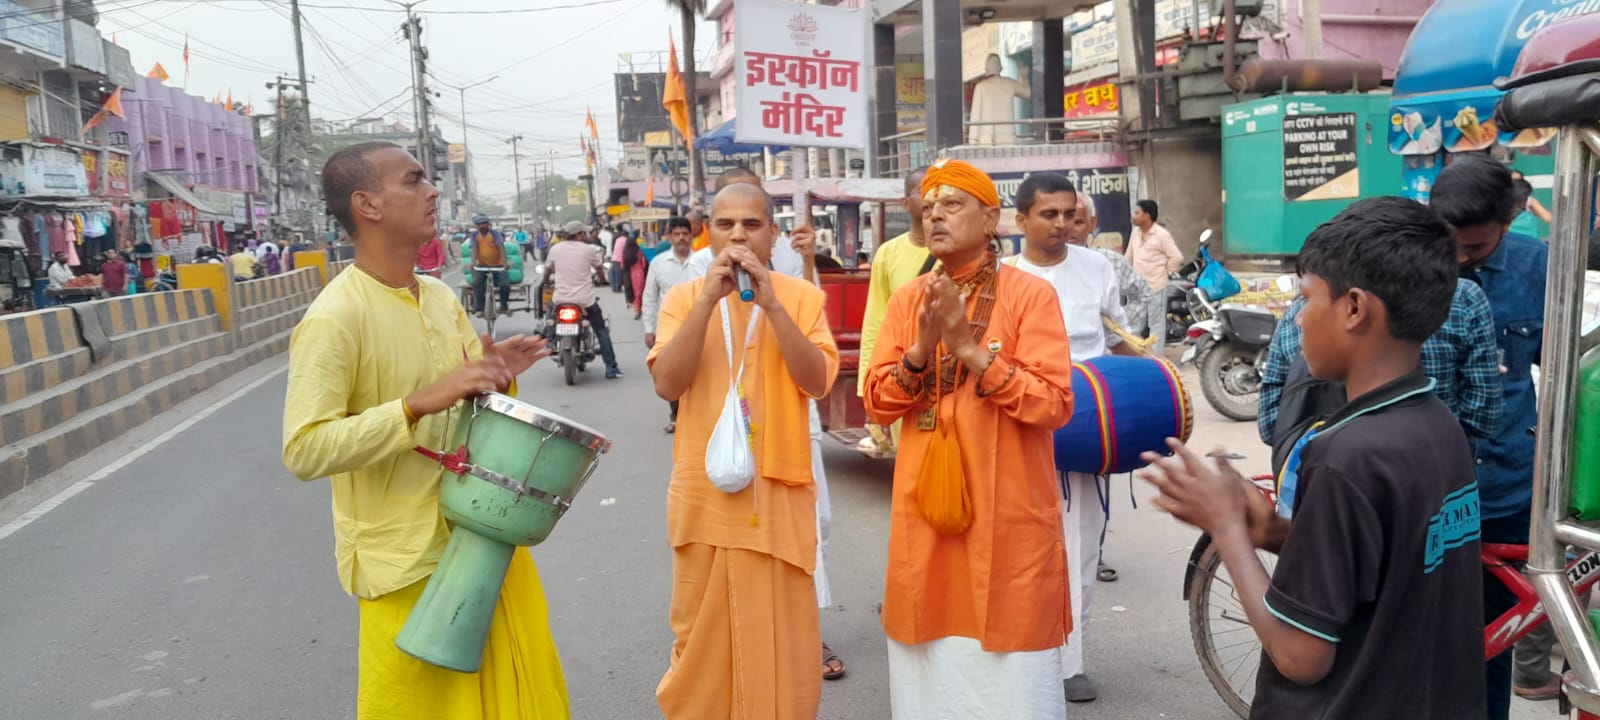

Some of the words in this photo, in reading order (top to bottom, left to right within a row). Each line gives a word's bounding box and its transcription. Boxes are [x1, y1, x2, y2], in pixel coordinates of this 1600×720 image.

[744, 49, 860, 92] इस्कॉन
[760, 92, 846, 137] मंदिर
[1296, 118, 1314, 129] CCTV
[1284, 131, 1317, 143] PARKING
[1318, 130, 1327, 141] AT
[1328, 129, 1348, 140] YOUR
[1299, 143, 1319, 154] OWN
[1319, 142, 1336, 152] RISK
[1567, 552, 1600, 585] ZON
